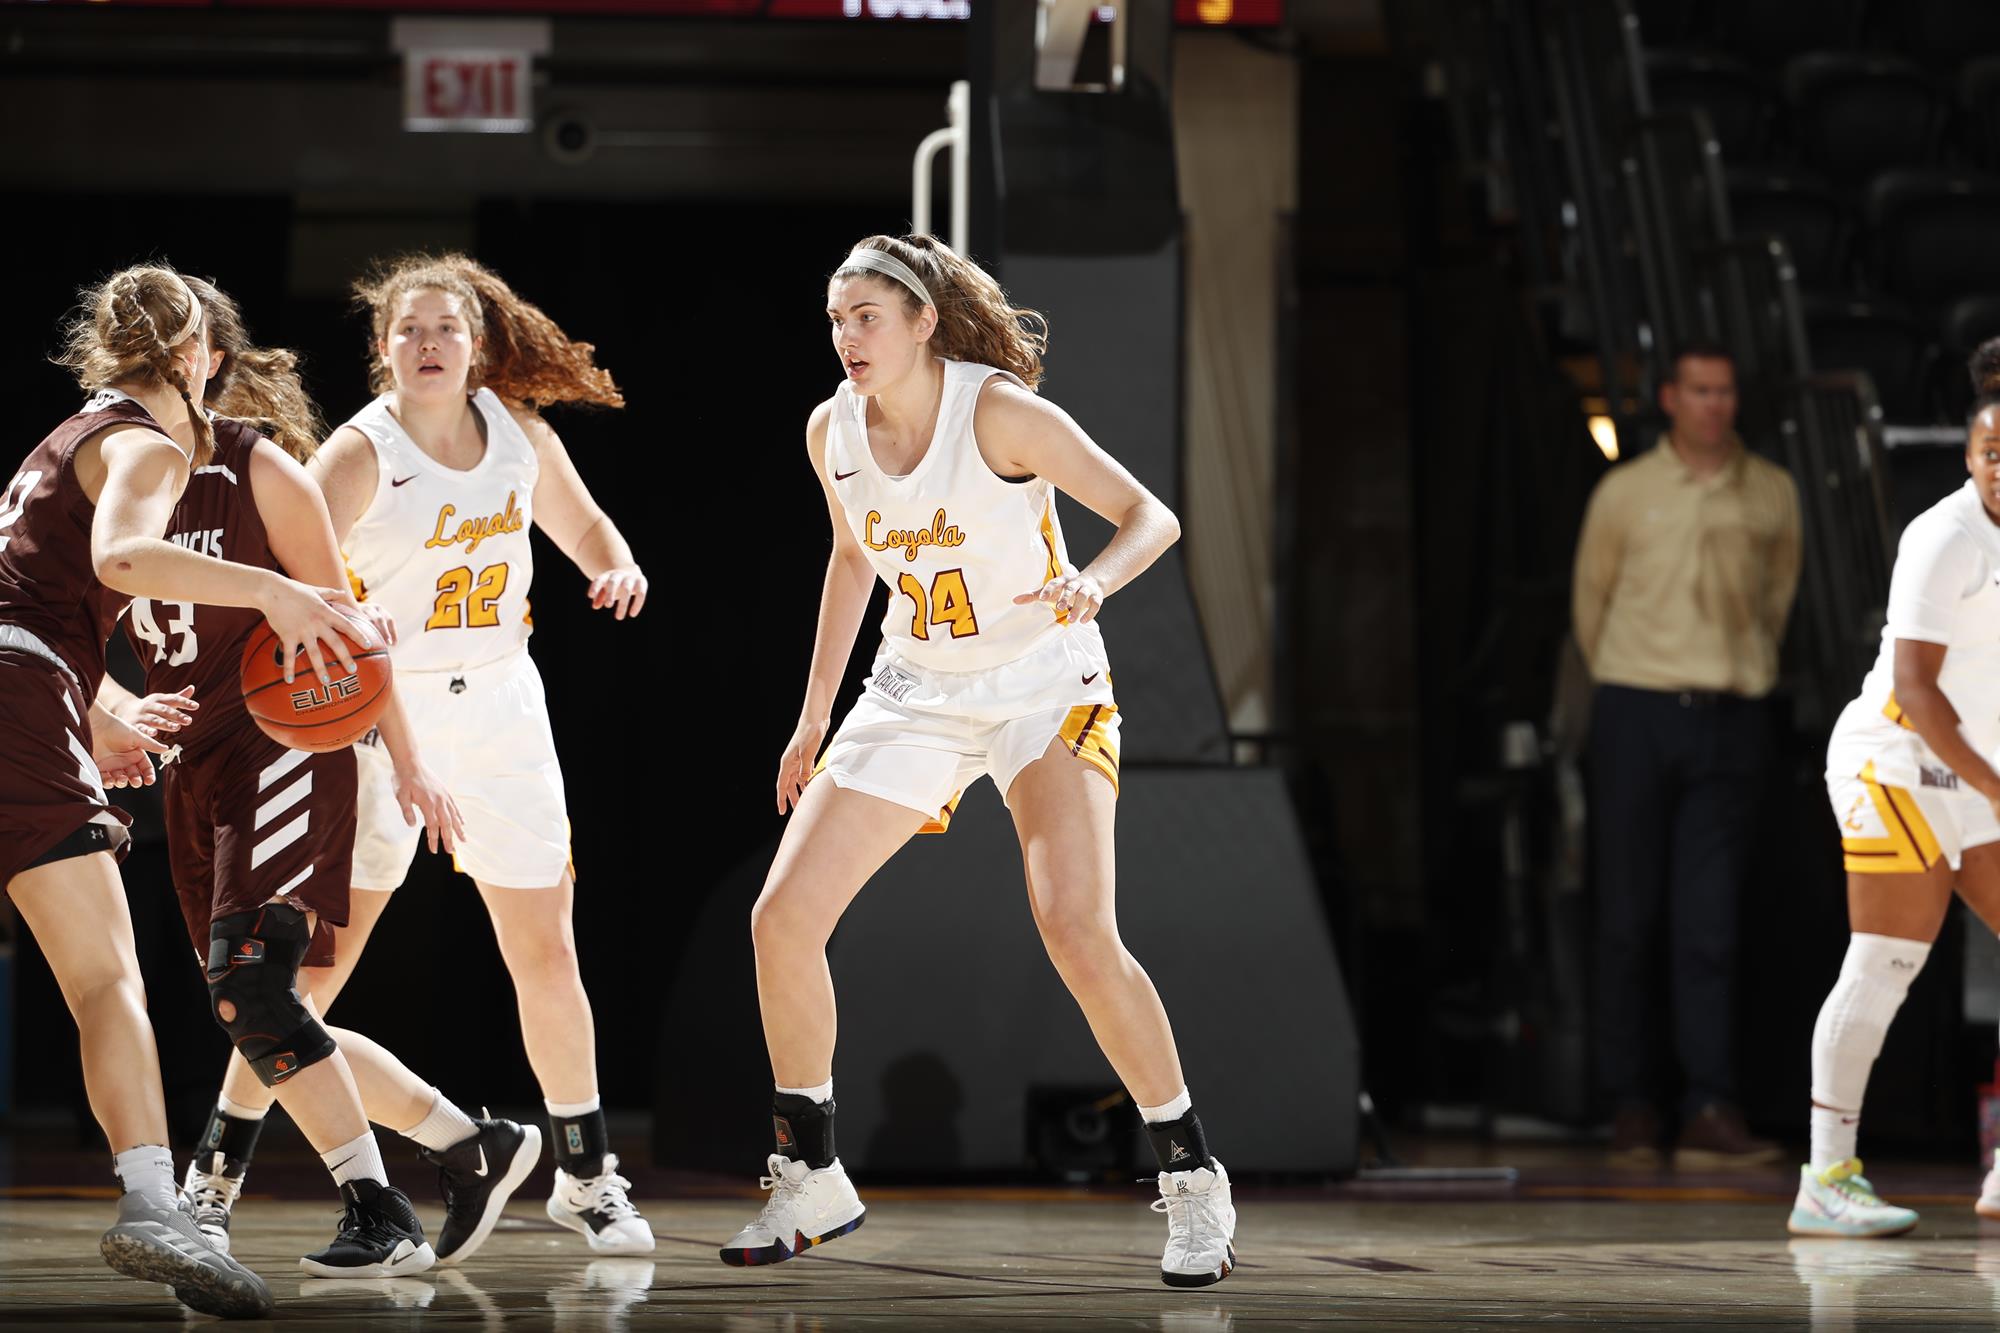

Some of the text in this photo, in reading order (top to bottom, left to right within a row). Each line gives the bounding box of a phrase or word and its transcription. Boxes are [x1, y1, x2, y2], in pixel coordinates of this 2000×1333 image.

[422, 59, 518, 118] EXIT
[424, 491, 523, 554] Loyola
[863, 508, 965, 562] Loyola
[424, 562, 509, 632] 22
[897, 568, 980, 641] 14
[291, 673, 362, 711] ELITE
